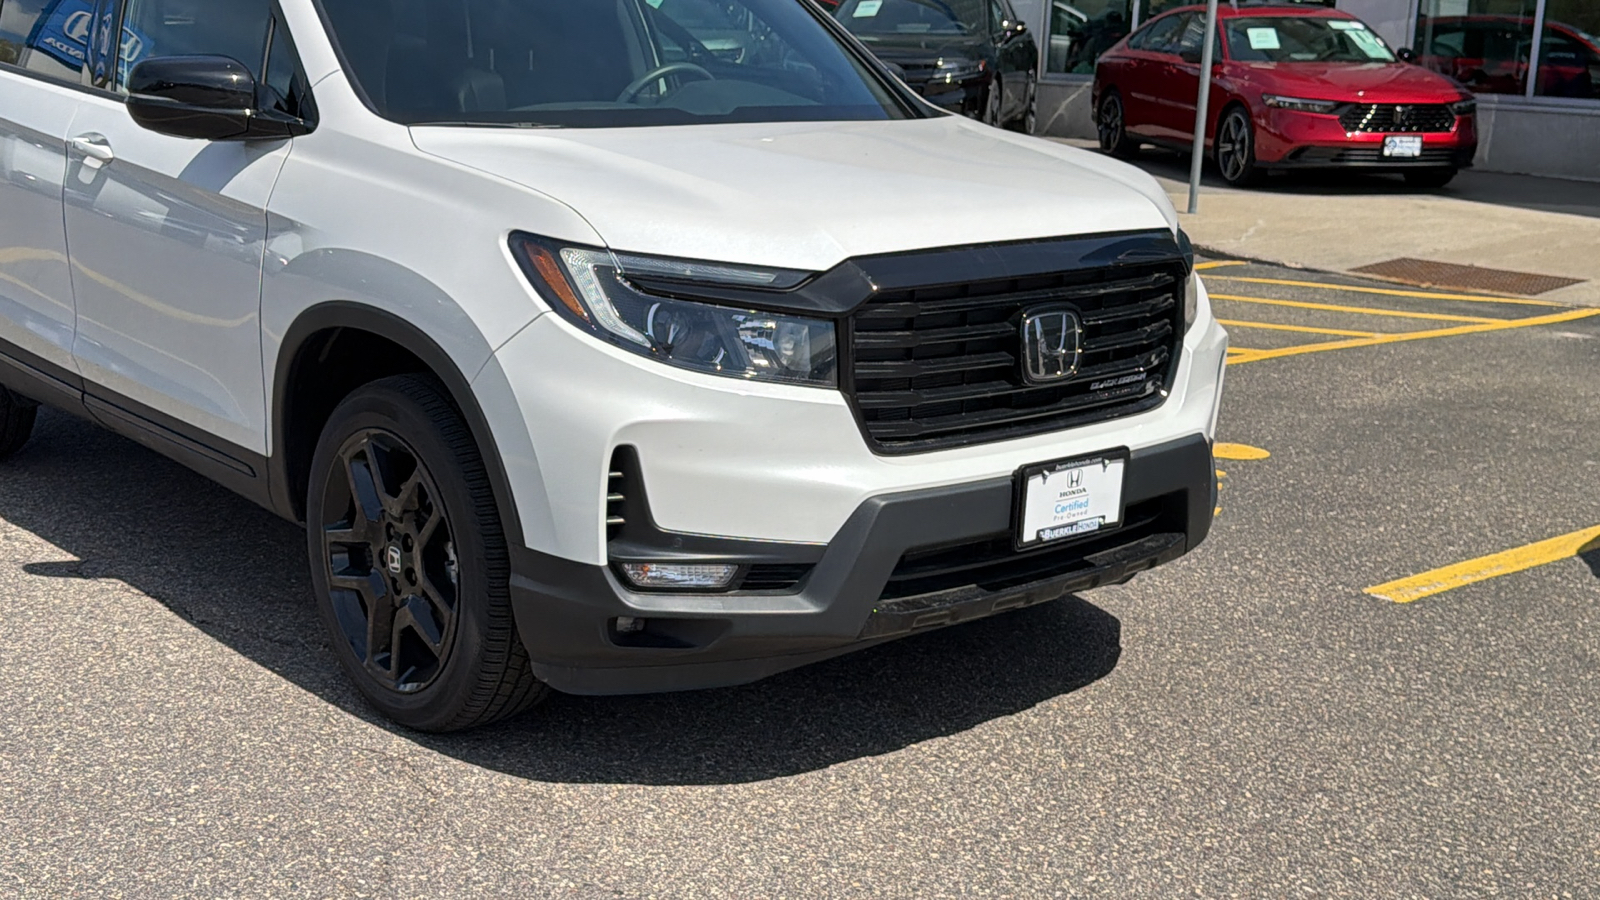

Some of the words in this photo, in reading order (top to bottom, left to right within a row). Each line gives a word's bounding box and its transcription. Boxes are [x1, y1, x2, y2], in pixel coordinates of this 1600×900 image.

[1059, 487, 1087, 498] HONDA
[1054, 498, 1089, 514] Certified
[1053, 509, 1088, 521] Pre-Owned
